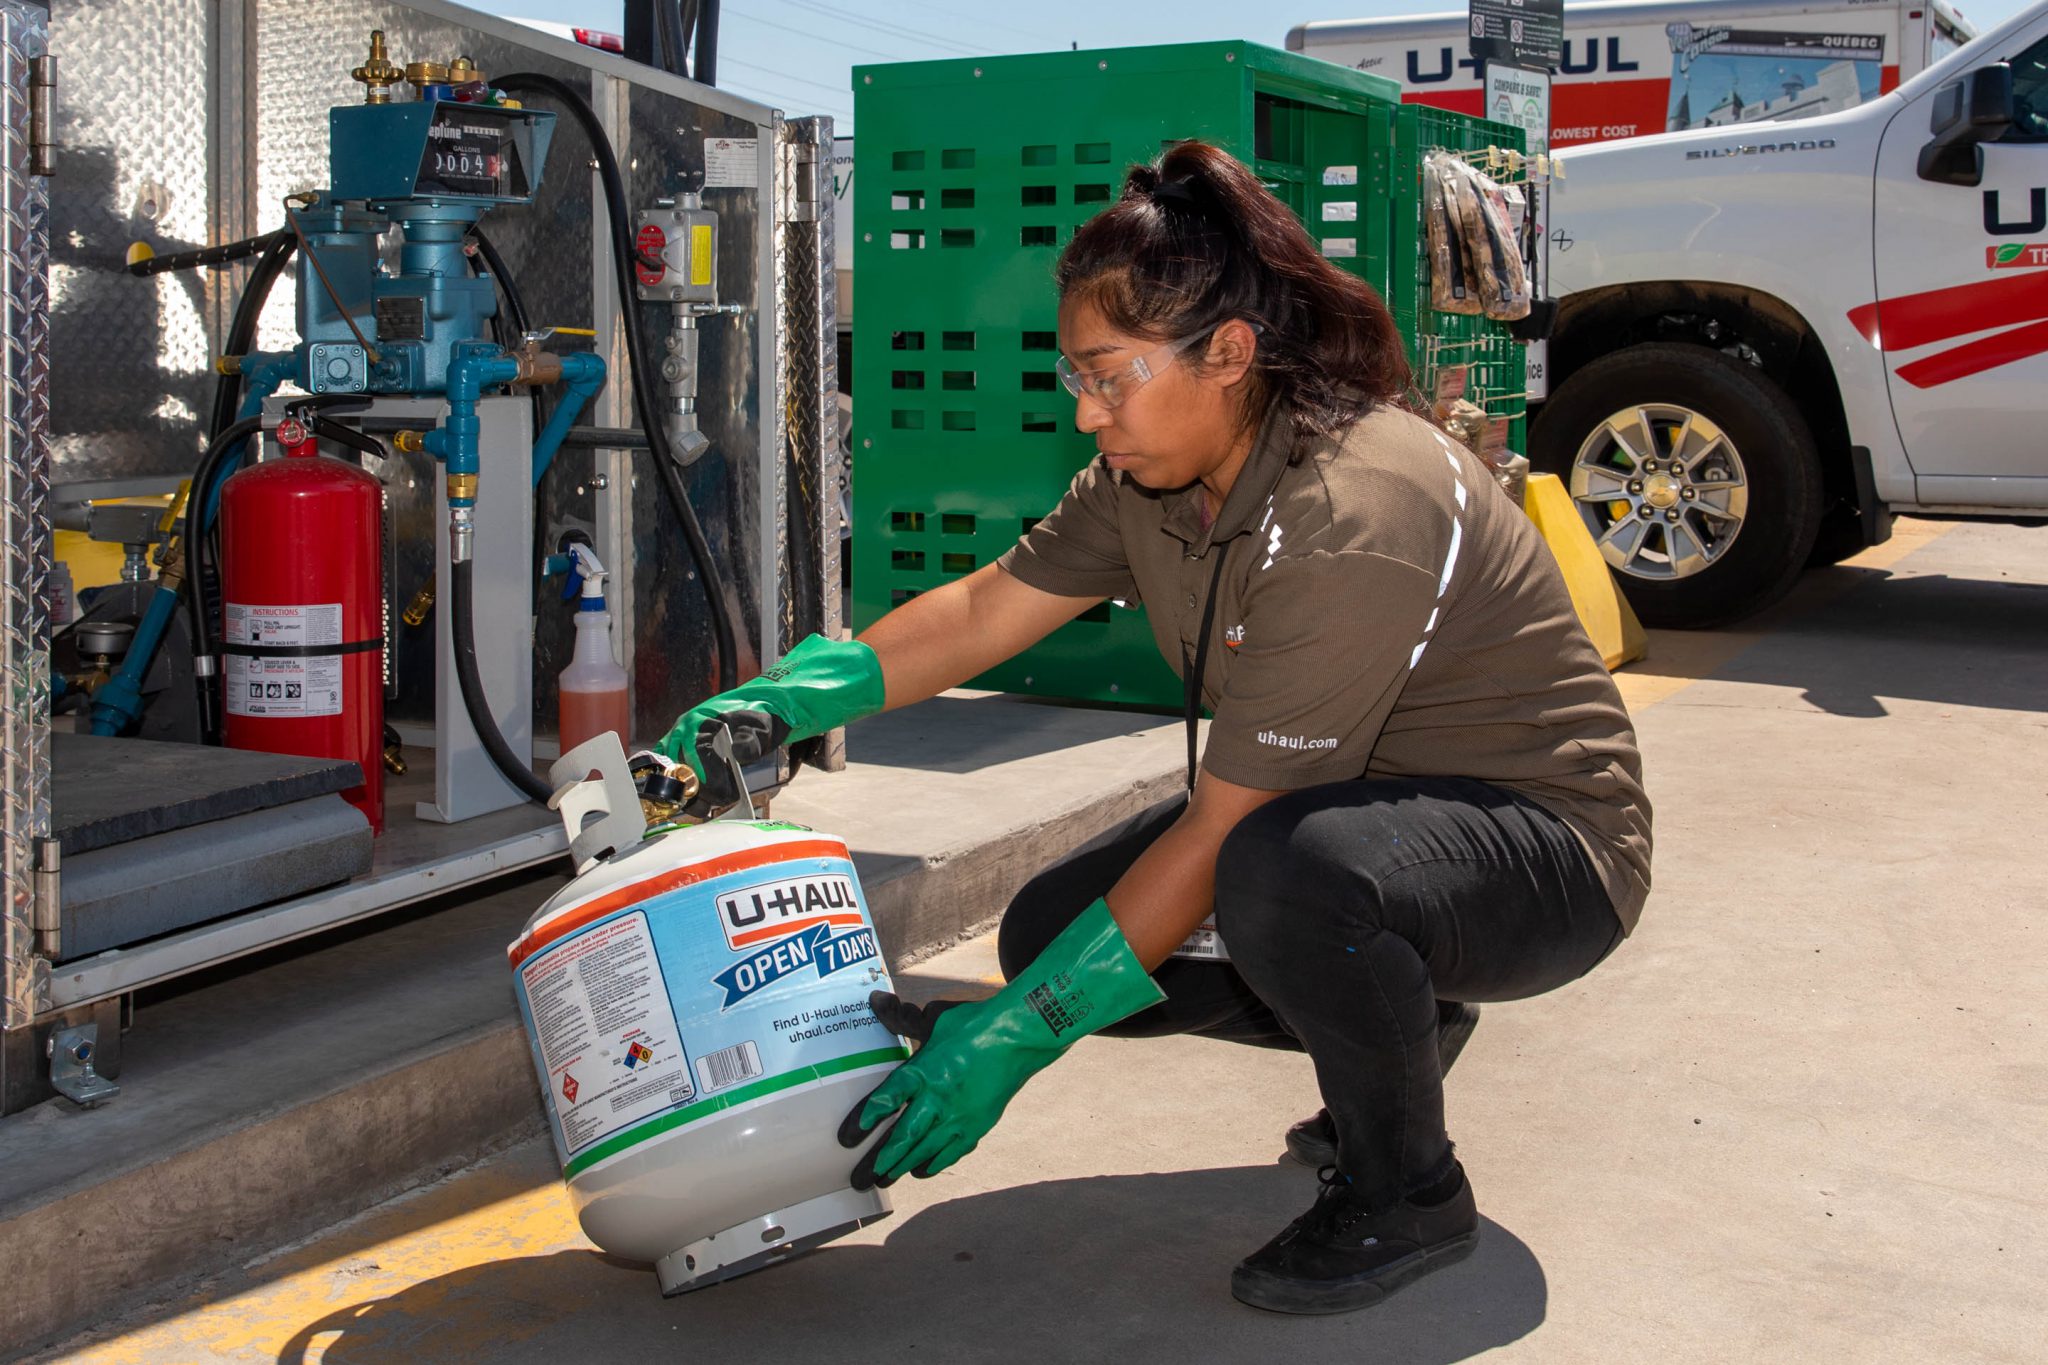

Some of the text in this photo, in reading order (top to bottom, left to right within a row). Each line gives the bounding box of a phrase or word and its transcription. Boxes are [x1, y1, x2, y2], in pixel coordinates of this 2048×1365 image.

[1679, 30, 1730, 73] Canada
[1822, 34, 1878, 48] QUÉBEC
[1406, 36, 1640, 85] U-UL
[1493, 78, 1520, 95] COMPARE
[428, 122, 461, 139] eptune
[1549, 124, 1637, 140] OWEST COST
[453, 145, 481, 153] GALLONS
[1686, 138, 1836, 160] SILVERADO
[252, 608, 299, 616] INSTRUCTIONS
[1257, 730, 1338, 750] uhaul.com
[726, 881, 857, 928] U-HAUL
[560, 942, 580, 958] propane
[581, 937, 591, 947] gas
[592, 929, 609, 940] under
[610, 917, 639, 933] pressure.
[821, 932, 875, 970] 7 DAYS
[734, 937, 809, 993] OPEN
[773, 1000, 871, 1031] Find U-Haul locatio
[789, 1015, 881, 1043] uhaul.com/propa
